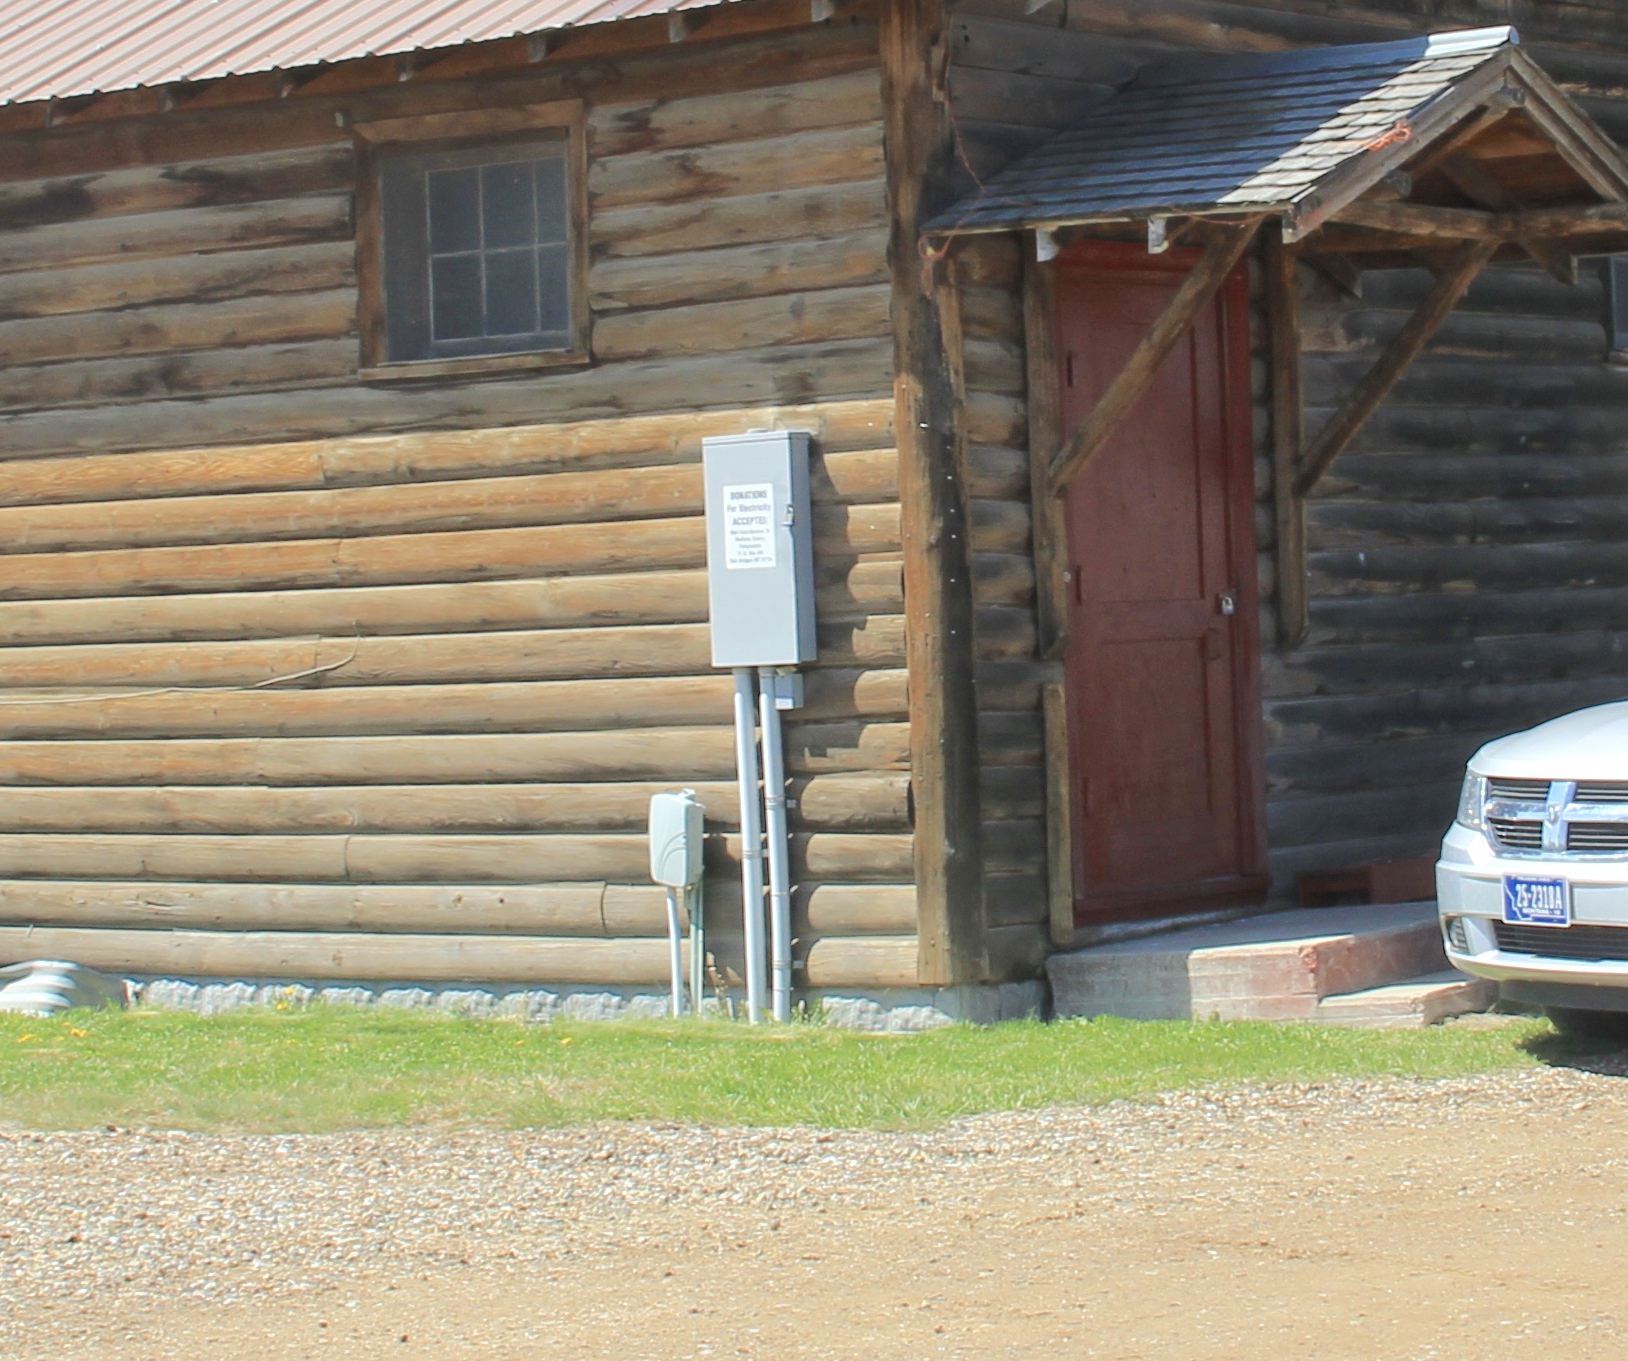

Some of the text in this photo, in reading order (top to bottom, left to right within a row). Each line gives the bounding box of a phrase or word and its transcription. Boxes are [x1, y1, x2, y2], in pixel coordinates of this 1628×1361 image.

[730, 491, 767, 500] DONATIONS
[726, 504, 771, 513] For Electricity
